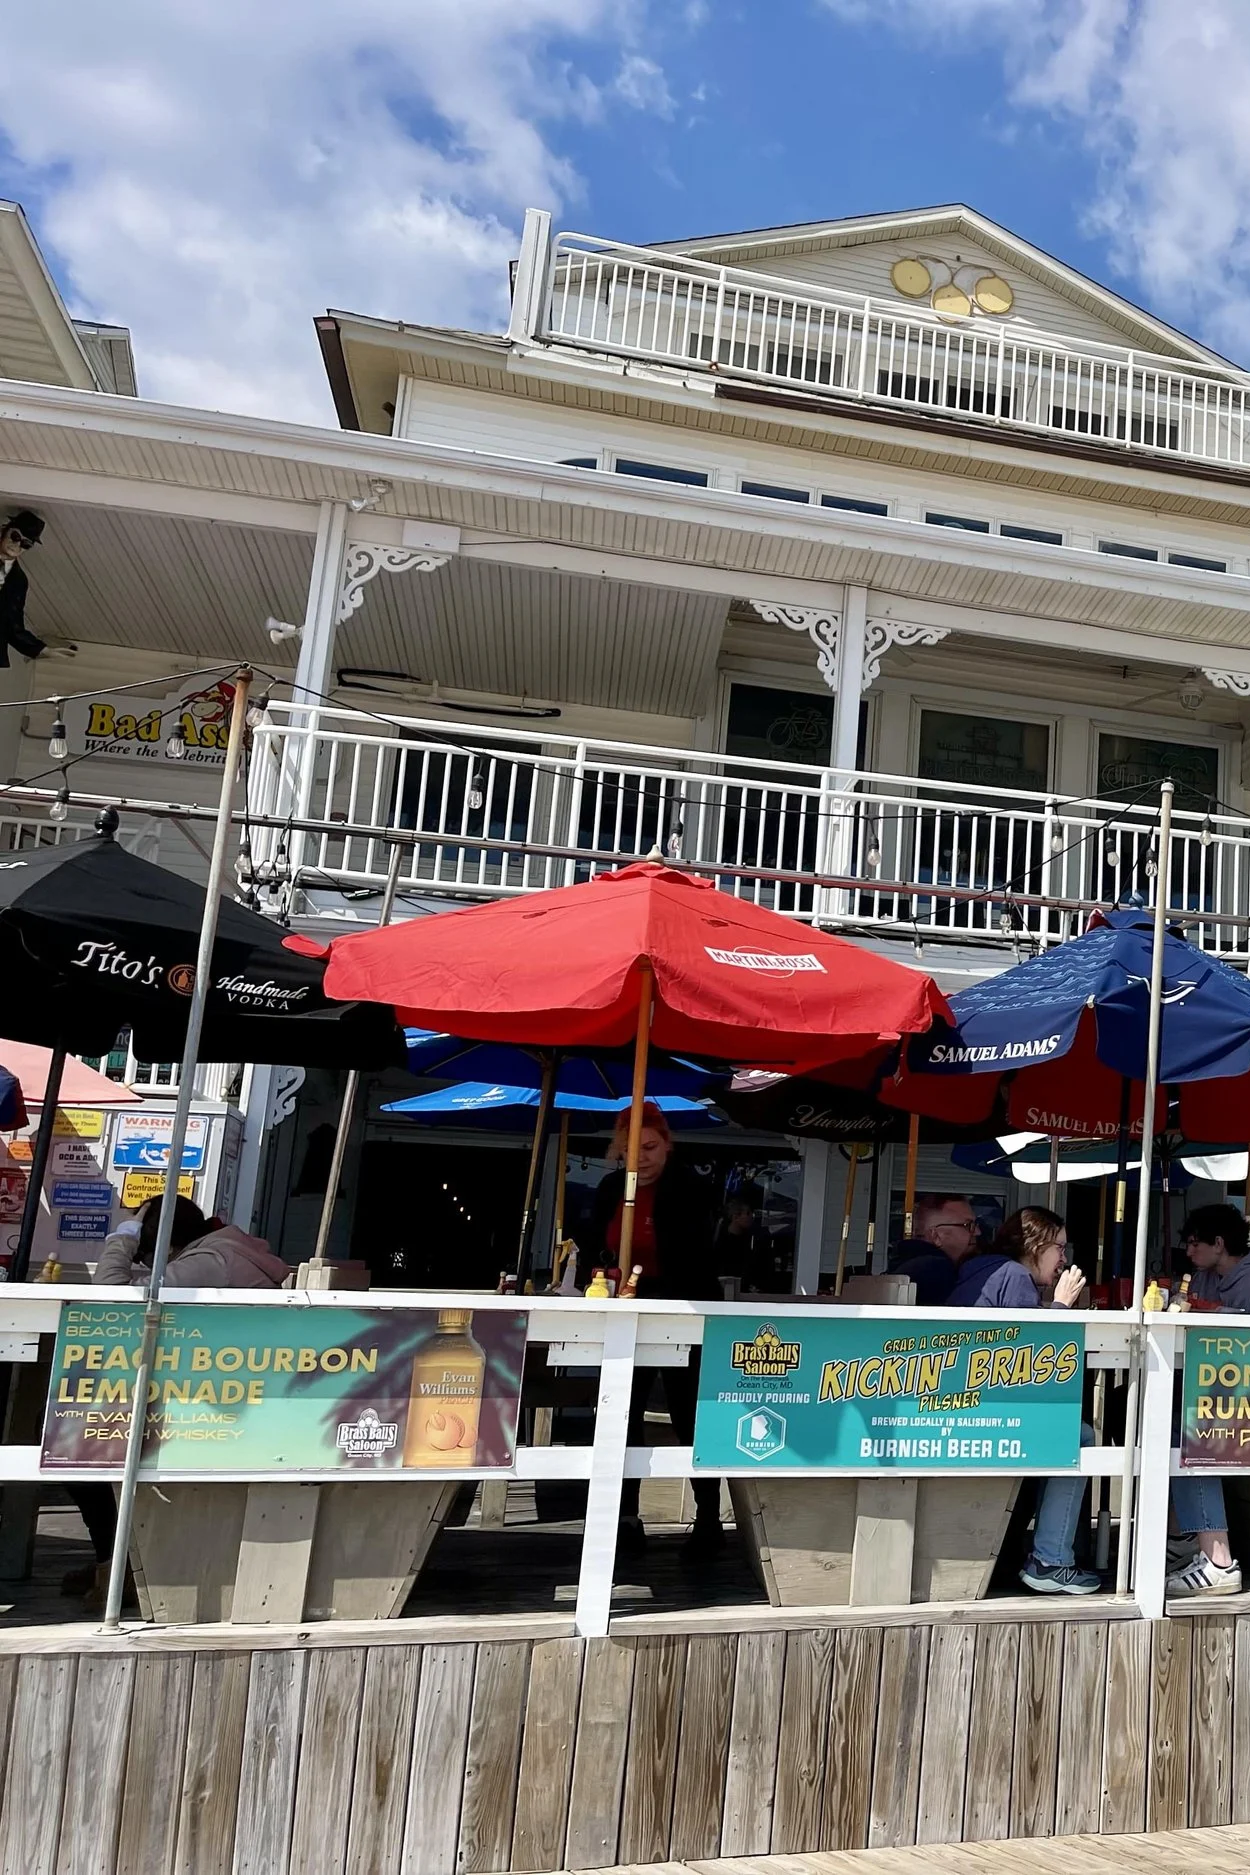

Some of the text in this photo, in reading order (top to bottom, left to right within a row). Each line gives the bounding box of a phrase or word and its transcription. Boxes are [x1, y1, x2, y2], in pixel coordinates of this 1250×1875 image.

[85, 702, 163, 743] Bad
[85, 739, 131, 755] Where
[136, 744, 159, 758] the
[216, 975, 310, 1000] Handmade
[227, 992, 289, 1011] VODKA
[929, 1034, 1061, 1063] SAMUEL ADAMS
[125, 1117, 201, 1128] WARNG
[1025, 1107, 1092, 1135] SAMUEL
[143, 1176, 159, 1184] This
[67, 1311, 136, 1323] ENJOY
[65, 1326, 132, 1338] BEACH
[189, 1328, 203, 1339] A
[883, 1327, 1020, 1354] GRAB A CRISPY PINT OF
[62, 1344, 378, 1373] PEACH BOURBON
[733, 1343, 799, 1364] Brass Balls
[745, 1361, 786, 1375] Saloon
[819, 1341, 1078, 1402] KICKIN' BRASS
[442, 1371, 477, 1383] Evan
[57, 1377, 265, 1405] LEMONADE
[419, 1383, 476, 1395] Williams
[736, 1381, 794, 1390] Ocean City, MD
[717, 1392, 811, 1404] PROUDLY POURING
[917, 1390, 982, 1413] PILSNER
[54, 1409, 84, 1418] WITH
[146, 1412, 238, 1424] WILLIAMS
[871, 1416, 1021, 1428] BREWED LOCALLY IN SALISBURY, MD
[155, 1428, 245, 1441] WHISKEY
[340, 1425, 395, 1442] Brass Balls
[940, 1427, 953, 1437] BY
[1196, 1427, 1235, 1440] WITH
[348, 1440, 383, 1451] Saloon
[860, 1438, 1027, 1458] BURNISH BEER CO.
